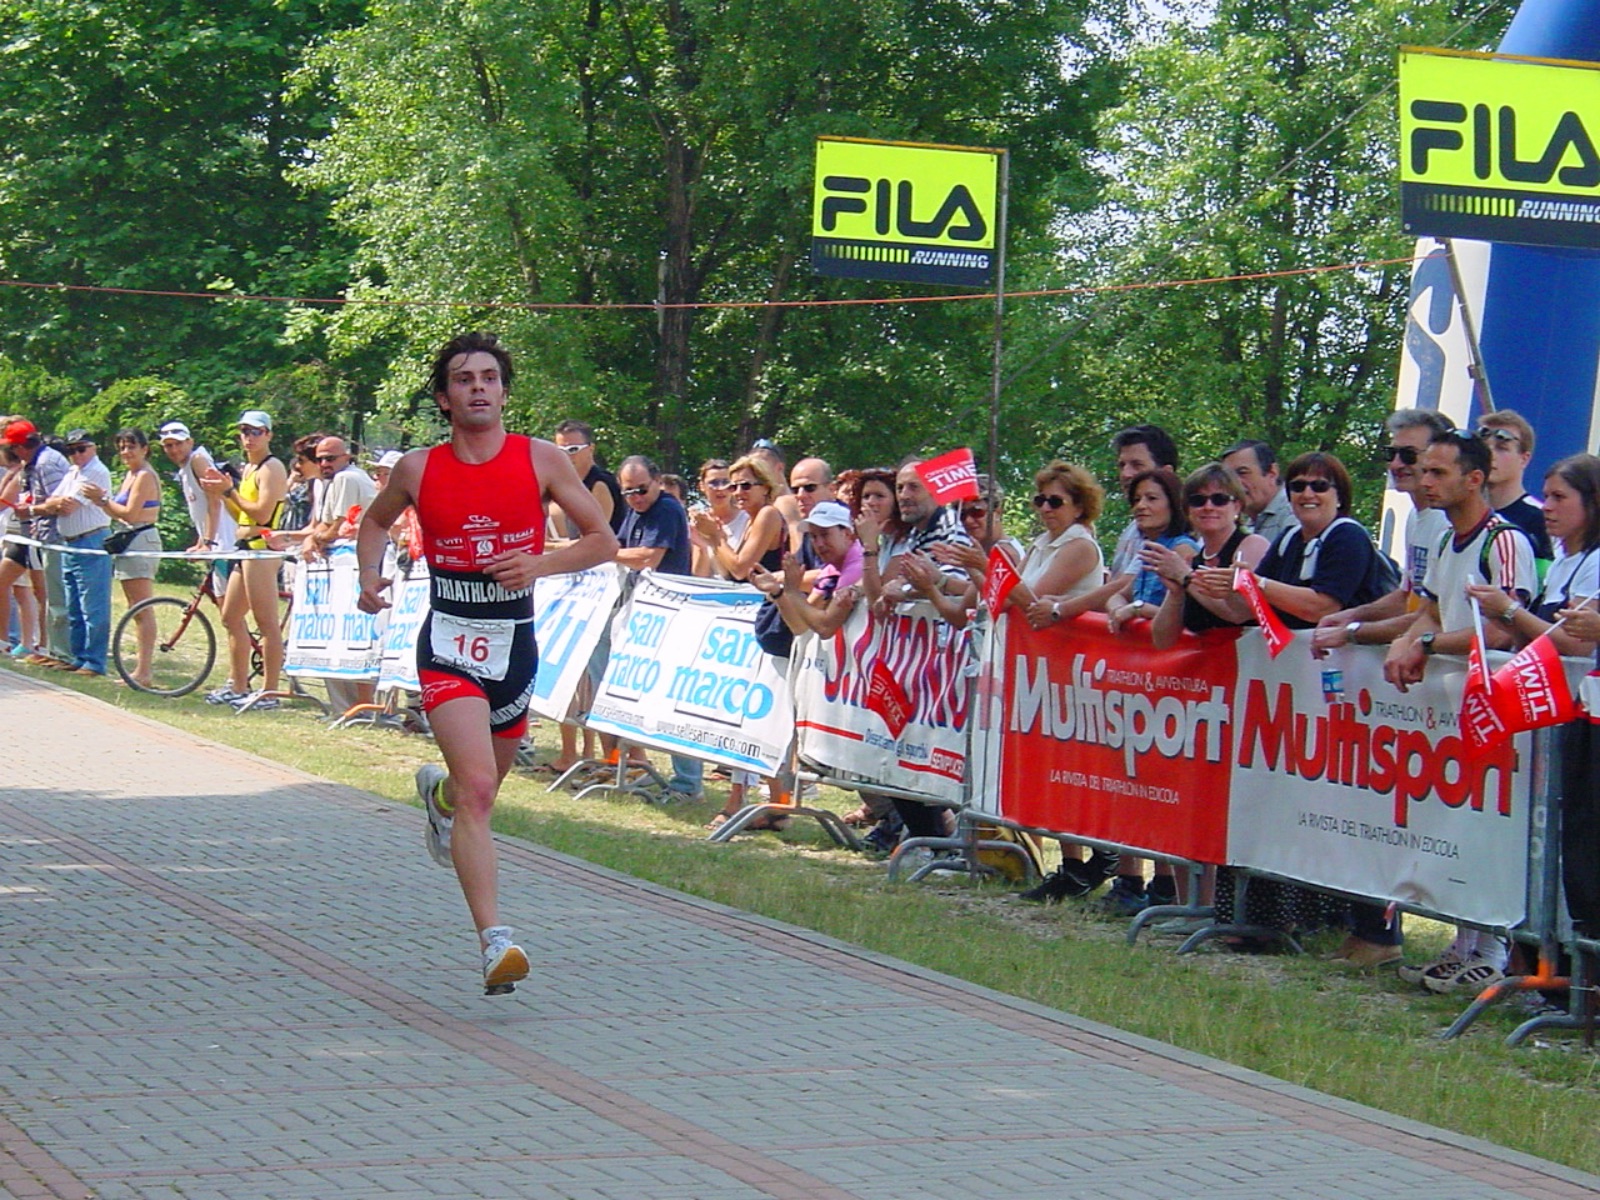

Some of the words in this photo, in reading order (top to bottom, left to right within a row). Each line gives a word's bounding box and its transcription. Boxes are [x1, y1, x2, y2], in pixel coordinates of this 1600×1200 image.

[1410, 99, 1600, 187] FILA
[821, 175, 987, 241] FILA
[911, 250, 990, 269] RUNNING
[453, 633, 490, 662] 16
[626, 609, 666, 649] san
[701, 625, 760, 669] san
[666, 665, 774, 720] marco
[1511, 650, 1549, 722] TIME
[1010, 653, 1230, 777] Multisport
[1375, 701, 1424, 722] TRIATHLON
[1050, 769, 1061, 783] LA
[1062, 770, 1087, 787] RIVISTA
[1148, 785, 1180, 804] EDICOLA
[1309, 812, 1339, 833] RIVISTA
[1341, 819, 1358, 837] DEL
[1360, 823, 1409, 847] TRIATHLON
[1409, 833, 1421, 850] IN
[1422, 836, 1460, 860] EDICOLA
